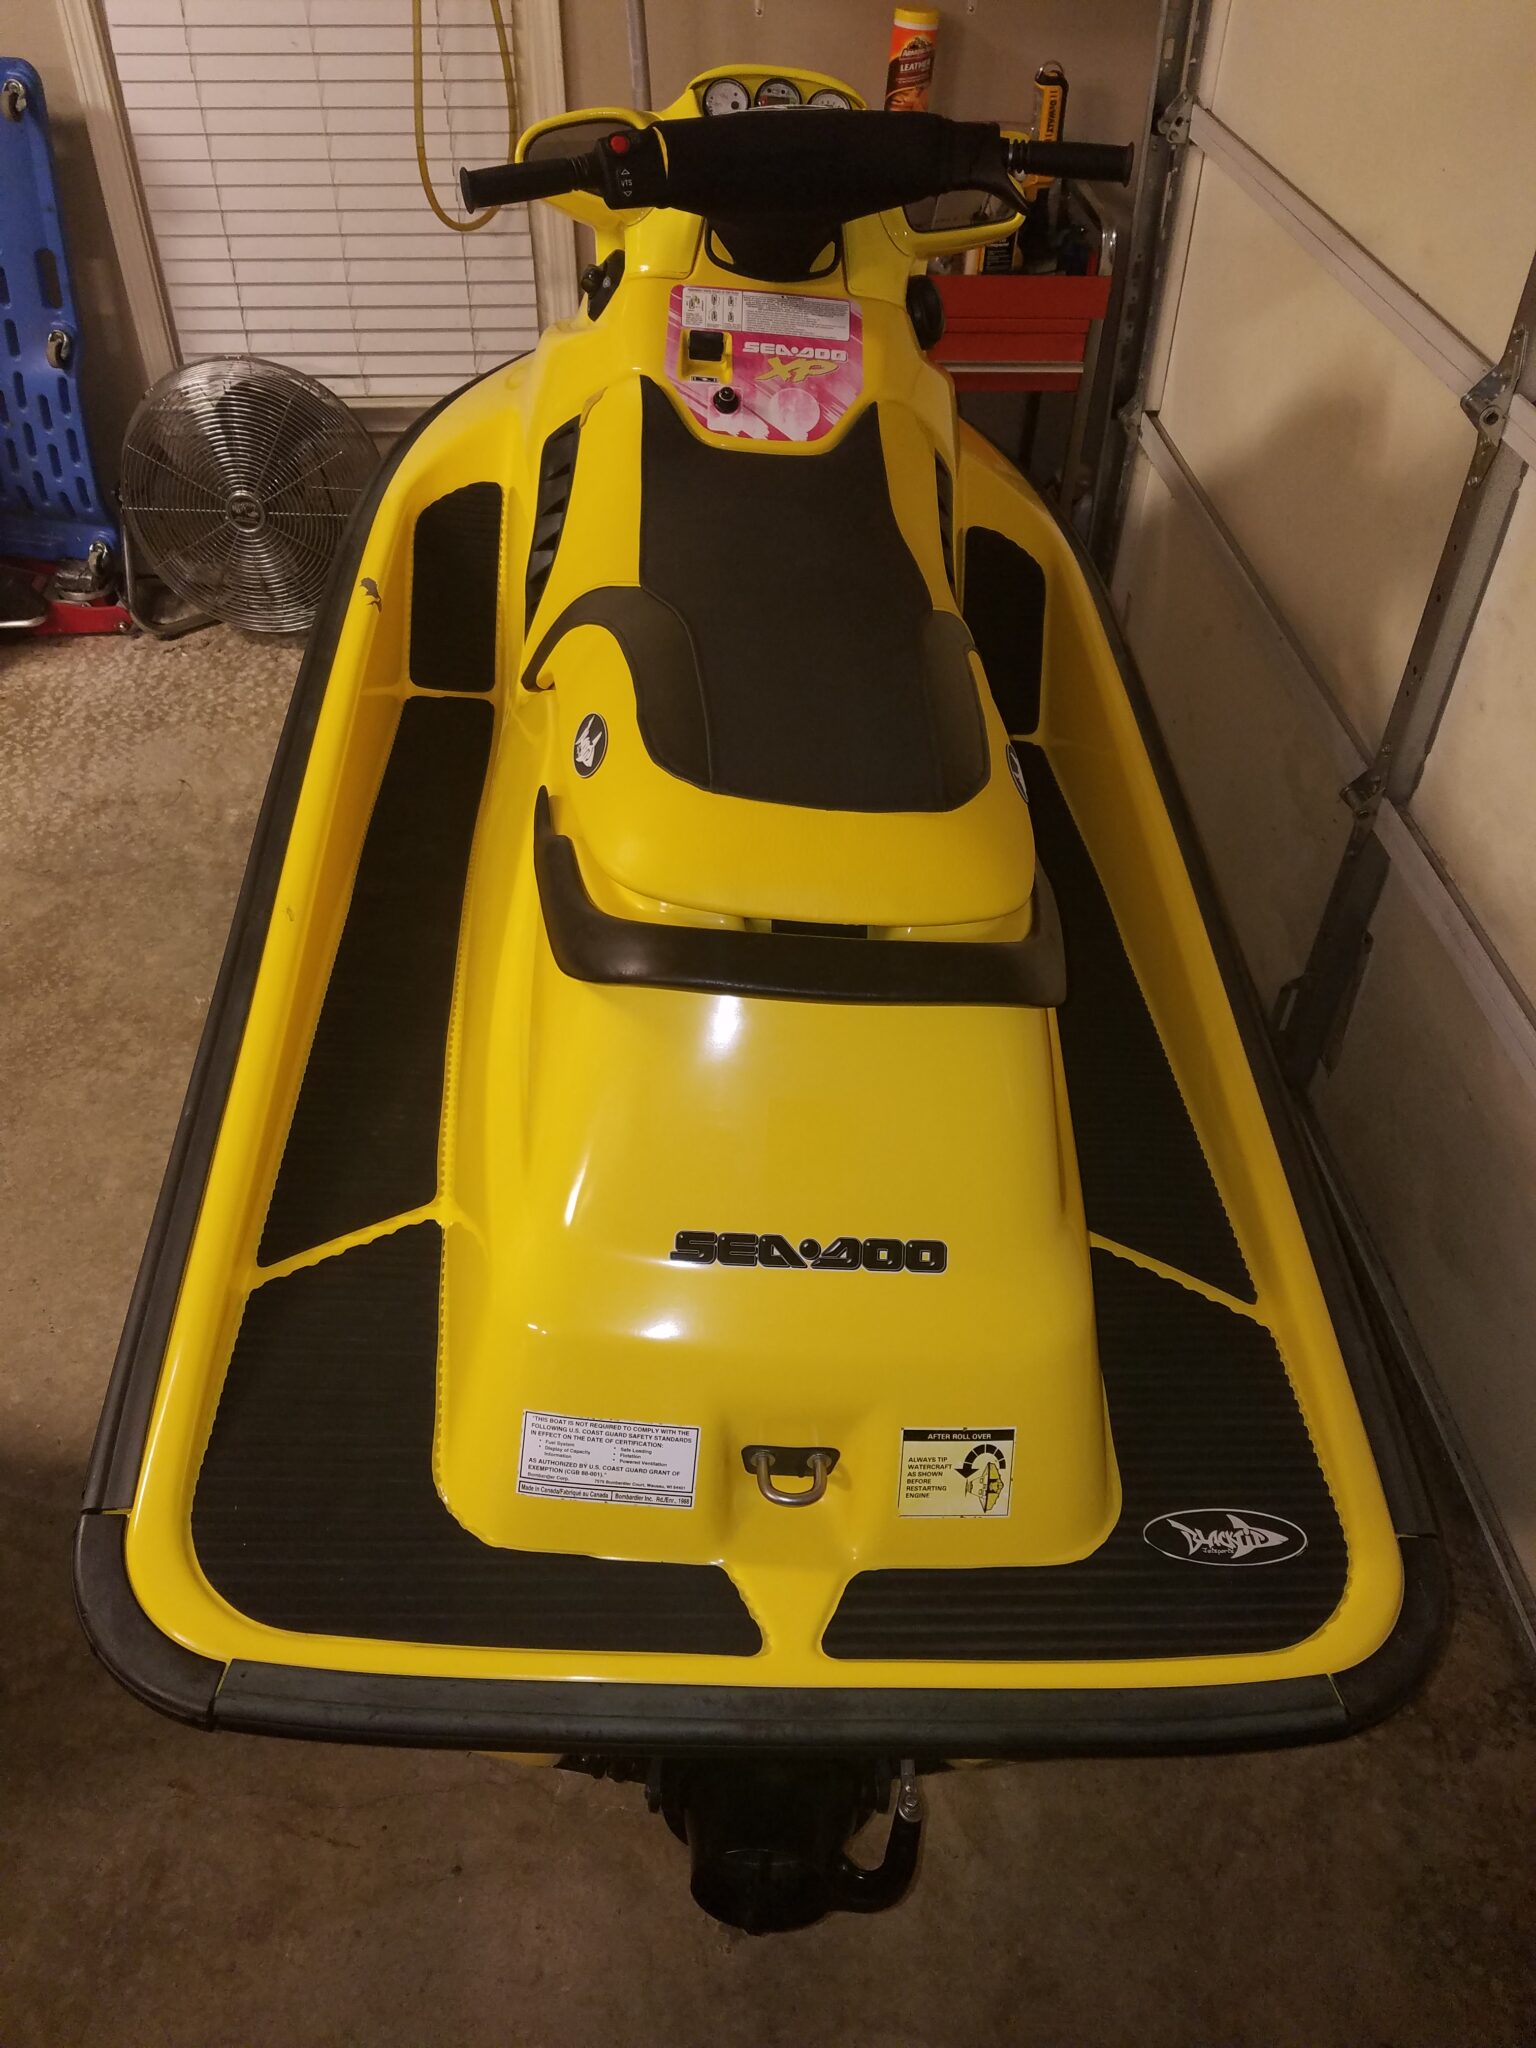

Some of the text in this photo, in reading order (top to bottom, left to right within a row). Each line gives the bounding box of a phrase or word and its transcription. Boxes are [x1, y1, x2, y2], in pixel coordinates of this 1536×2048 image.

[621, 179, 633, 187] VTS
[754, 356, 840, 384] XP
[531, 1422, 568, 1433] FOLLOWING
[654, 1435, 692, 1443] STANDARDS
[590, 1422, 622, 1431] REQUIRED
[633, 1426, 659, 1434] COMPLY
[614, 1439, 664, 1448] CERTIFICATION:
[538, 1458, 578, 1468] AUTHORIZED
[527, 1464, 563, 1474] EXEMPTION
[615, 1493, 644, 1501] Bombardier
